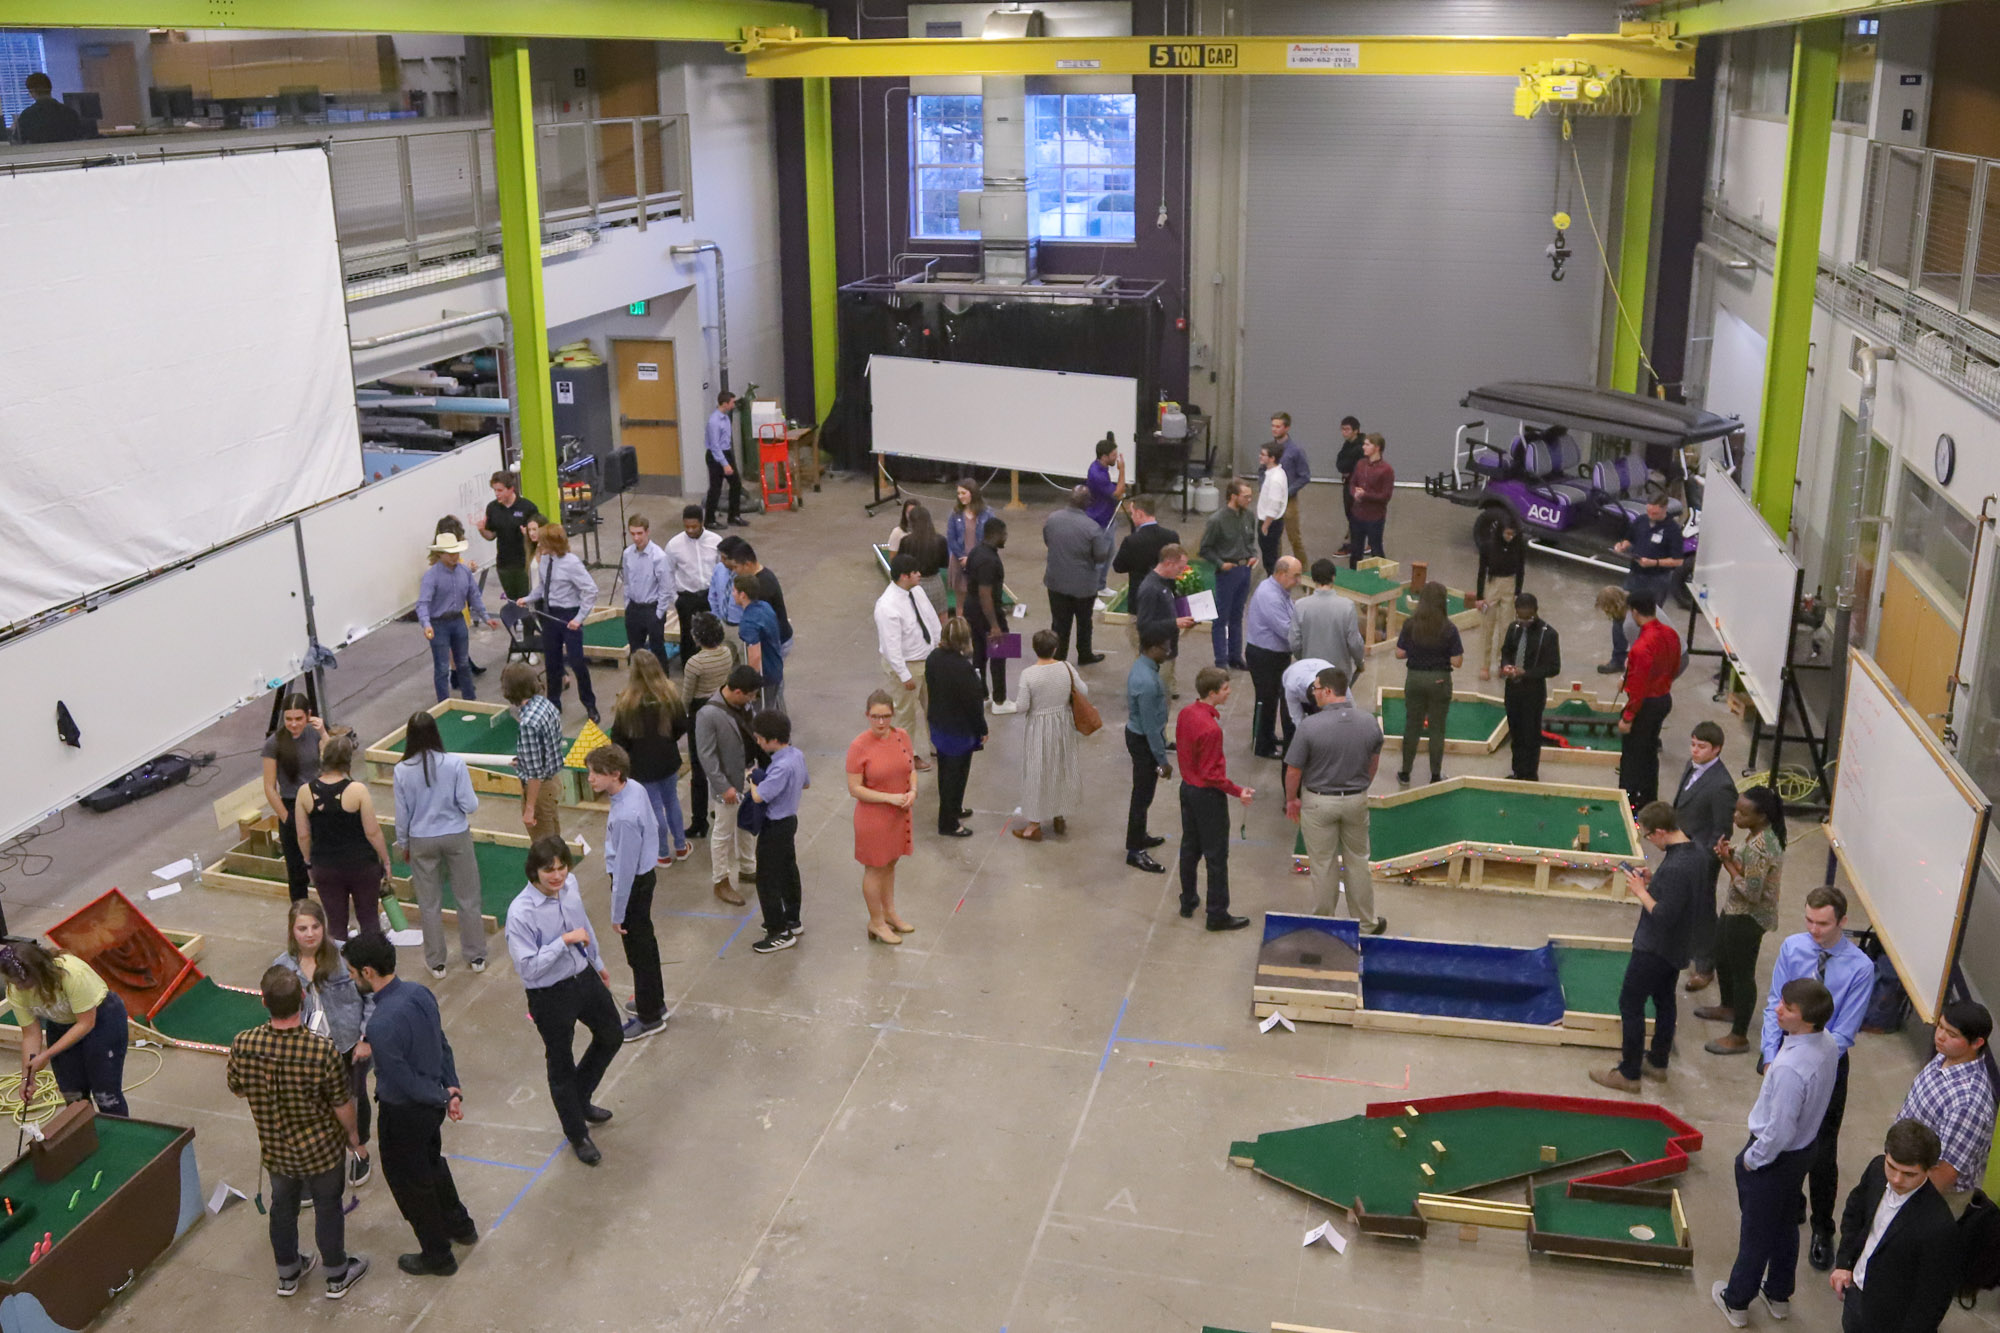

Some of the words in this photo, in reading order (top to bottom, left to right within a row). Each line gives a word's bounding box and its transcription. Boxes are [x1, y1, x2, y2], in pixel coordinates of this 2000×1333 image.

[1154, 46, 1170, 66] 5
[1173, 45, 1201, 66] TON
[1208, 48, 1233, 64] CAP.
[1527, 503, 1561, 524] ACU
